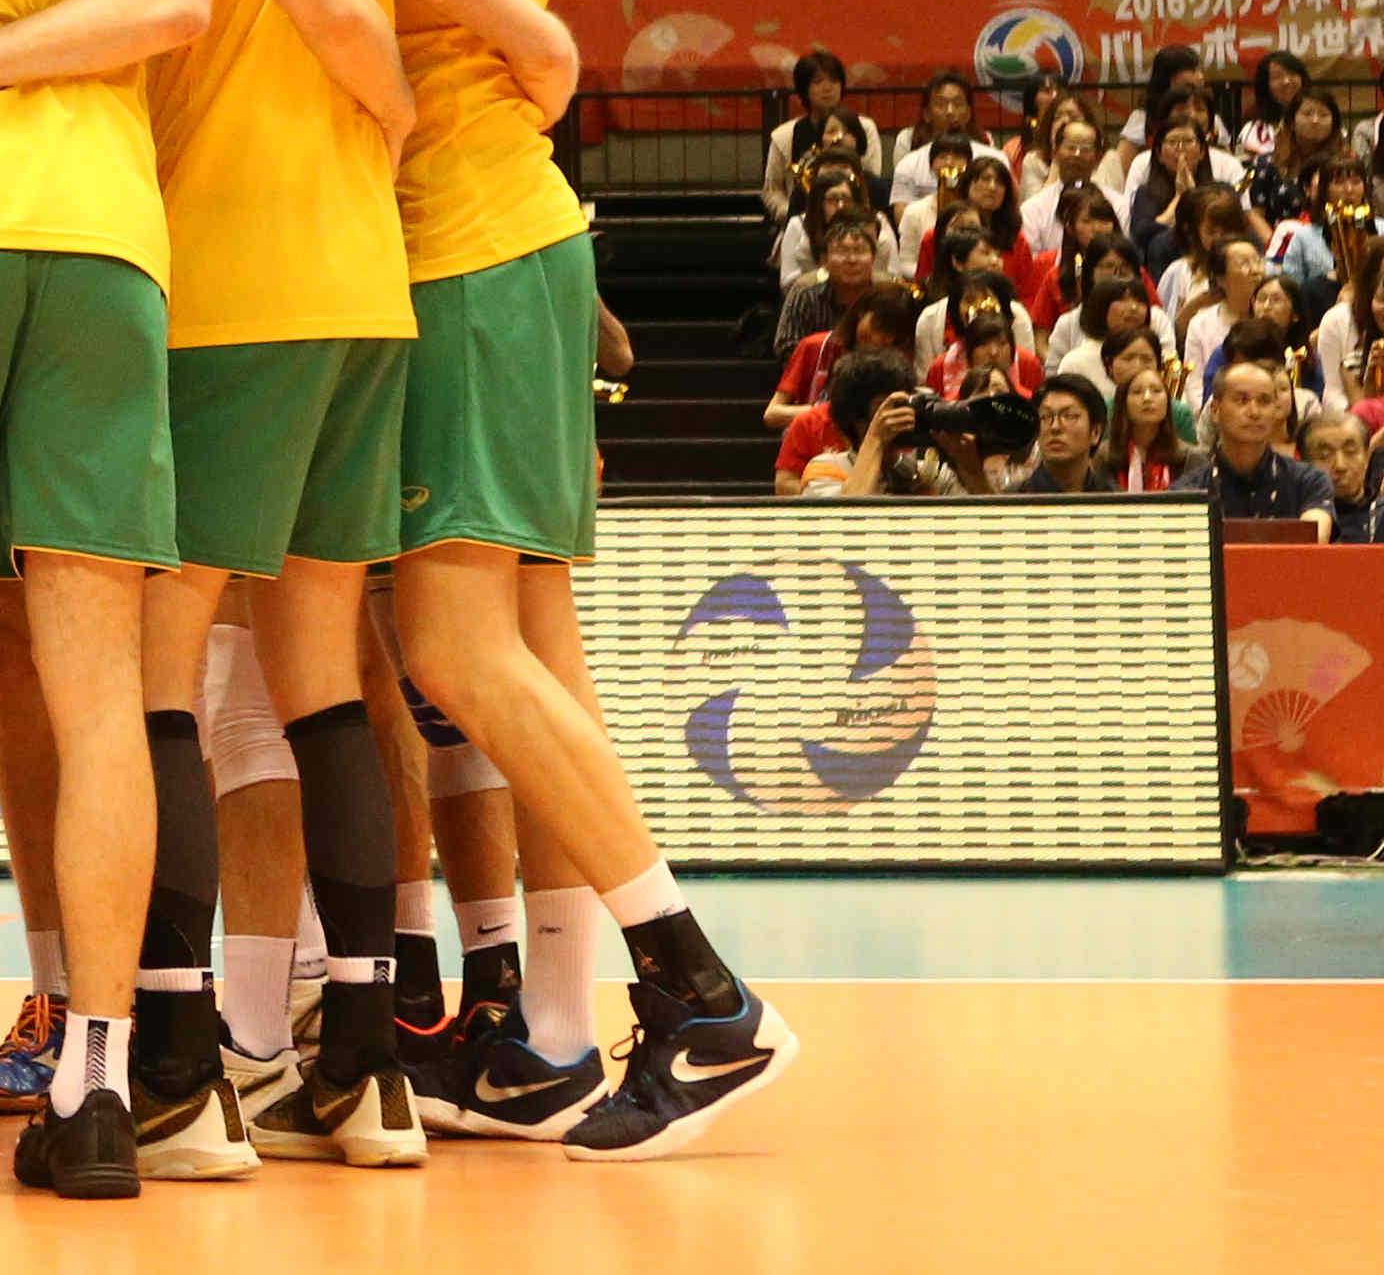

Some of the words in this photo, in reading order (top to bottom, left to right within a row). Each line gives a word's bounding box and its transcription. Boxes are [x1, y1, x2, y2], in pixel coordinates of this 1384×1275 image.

[1099, 17, 1384, 83] バレボール世界
